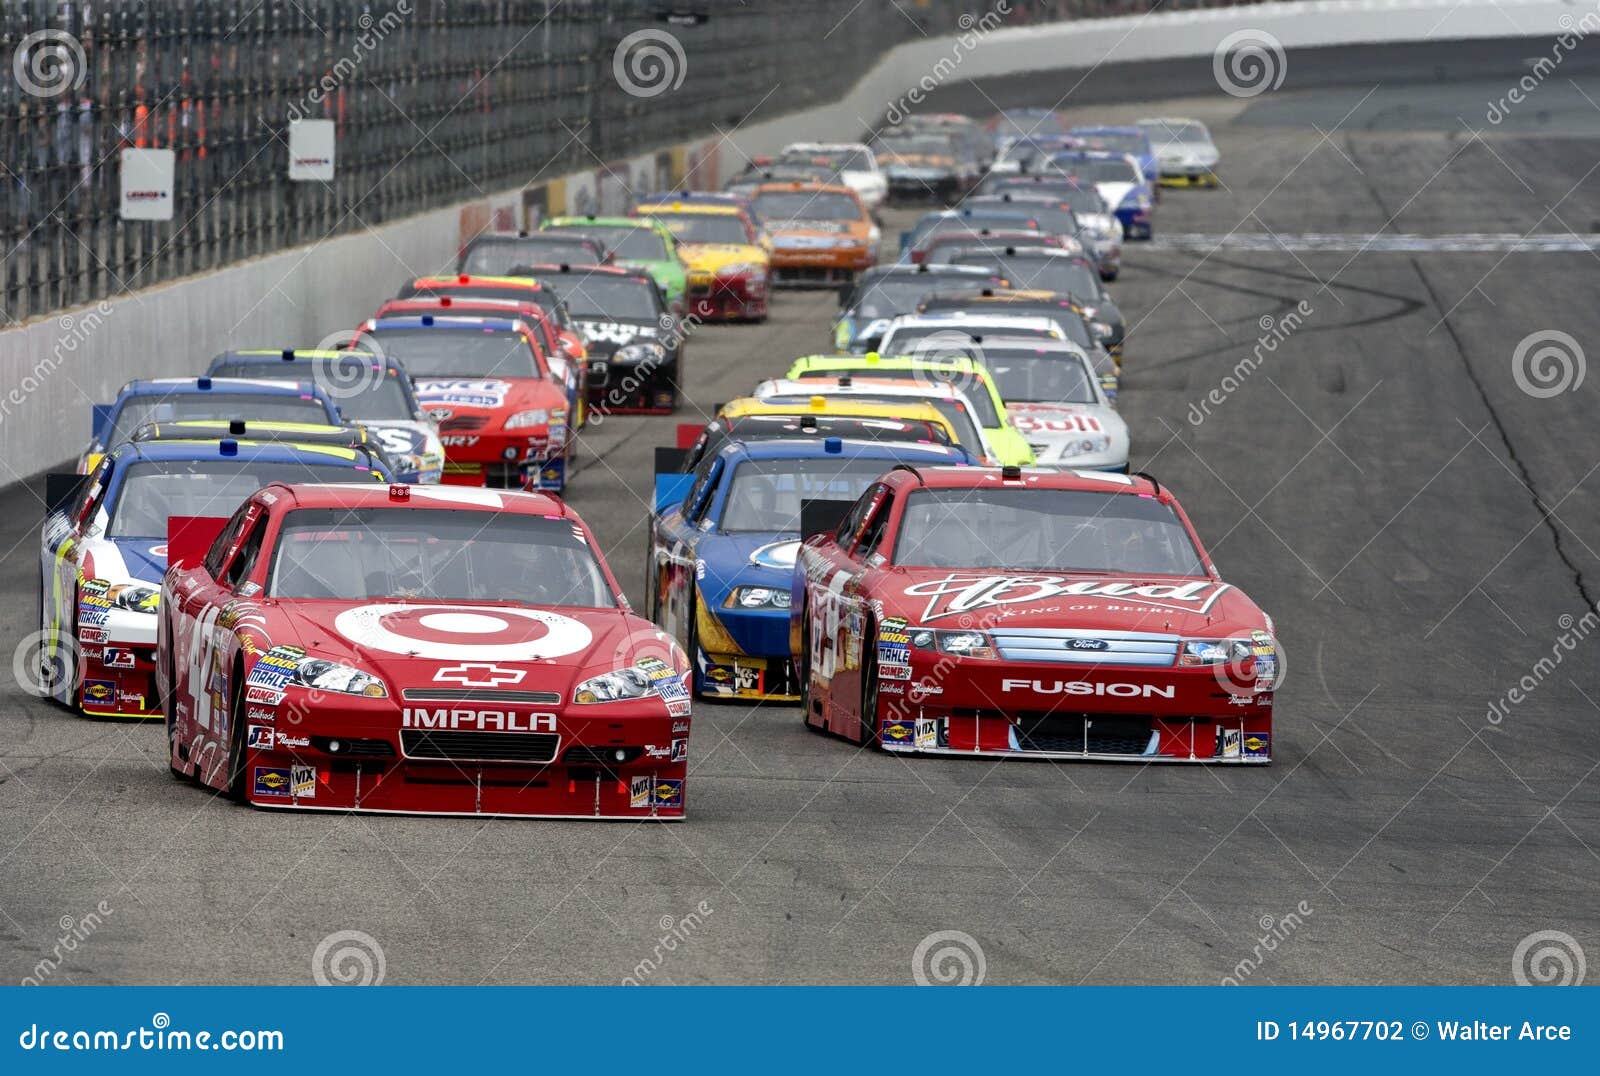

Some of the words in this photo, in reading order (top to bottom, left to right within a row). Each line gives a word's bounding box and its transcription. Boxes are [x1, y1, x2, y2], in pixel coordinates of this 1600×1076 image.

[1009, 415, 1101, 432] Bull
[746, 588, 773, 607] 2
[904, 574, 1202, 611] Bud
[82, 595, 113, 608] MOOG
[80, 610, 111, 626] MAHLE
[1001, 605, 1060, 619] KING
[1069, 604, 1099, 612] OF
[1106, 604, 1175, 614] BEERS
[81, 629, 102, 641] COMP
[879, 632, 910, 644] MOOG
[947, 635, 976, 651] 9
[1073, 638, 1102, 650] Ford
[261, 656, 298, 670] MOOG
[879, 650, 910, 664] MAHLE
[248, 669, 290, 689] MAHLE
[880, 666, 903, 676] COMP
[85, 687, 113, 695] SUNOCO
[248, 688, 275, 701] COMP
[1001, 679, 1176, 699] FUSION
[402, 707, 558, 732] IMPALA
[916, 721, 935, 737] WIX
[1224, 731, 1239, 747] WIX
[257, 776, 289, 785] SUNOCO
[291, 768, 315, 784] WIX
[631, 777, 649, 797] WIX
